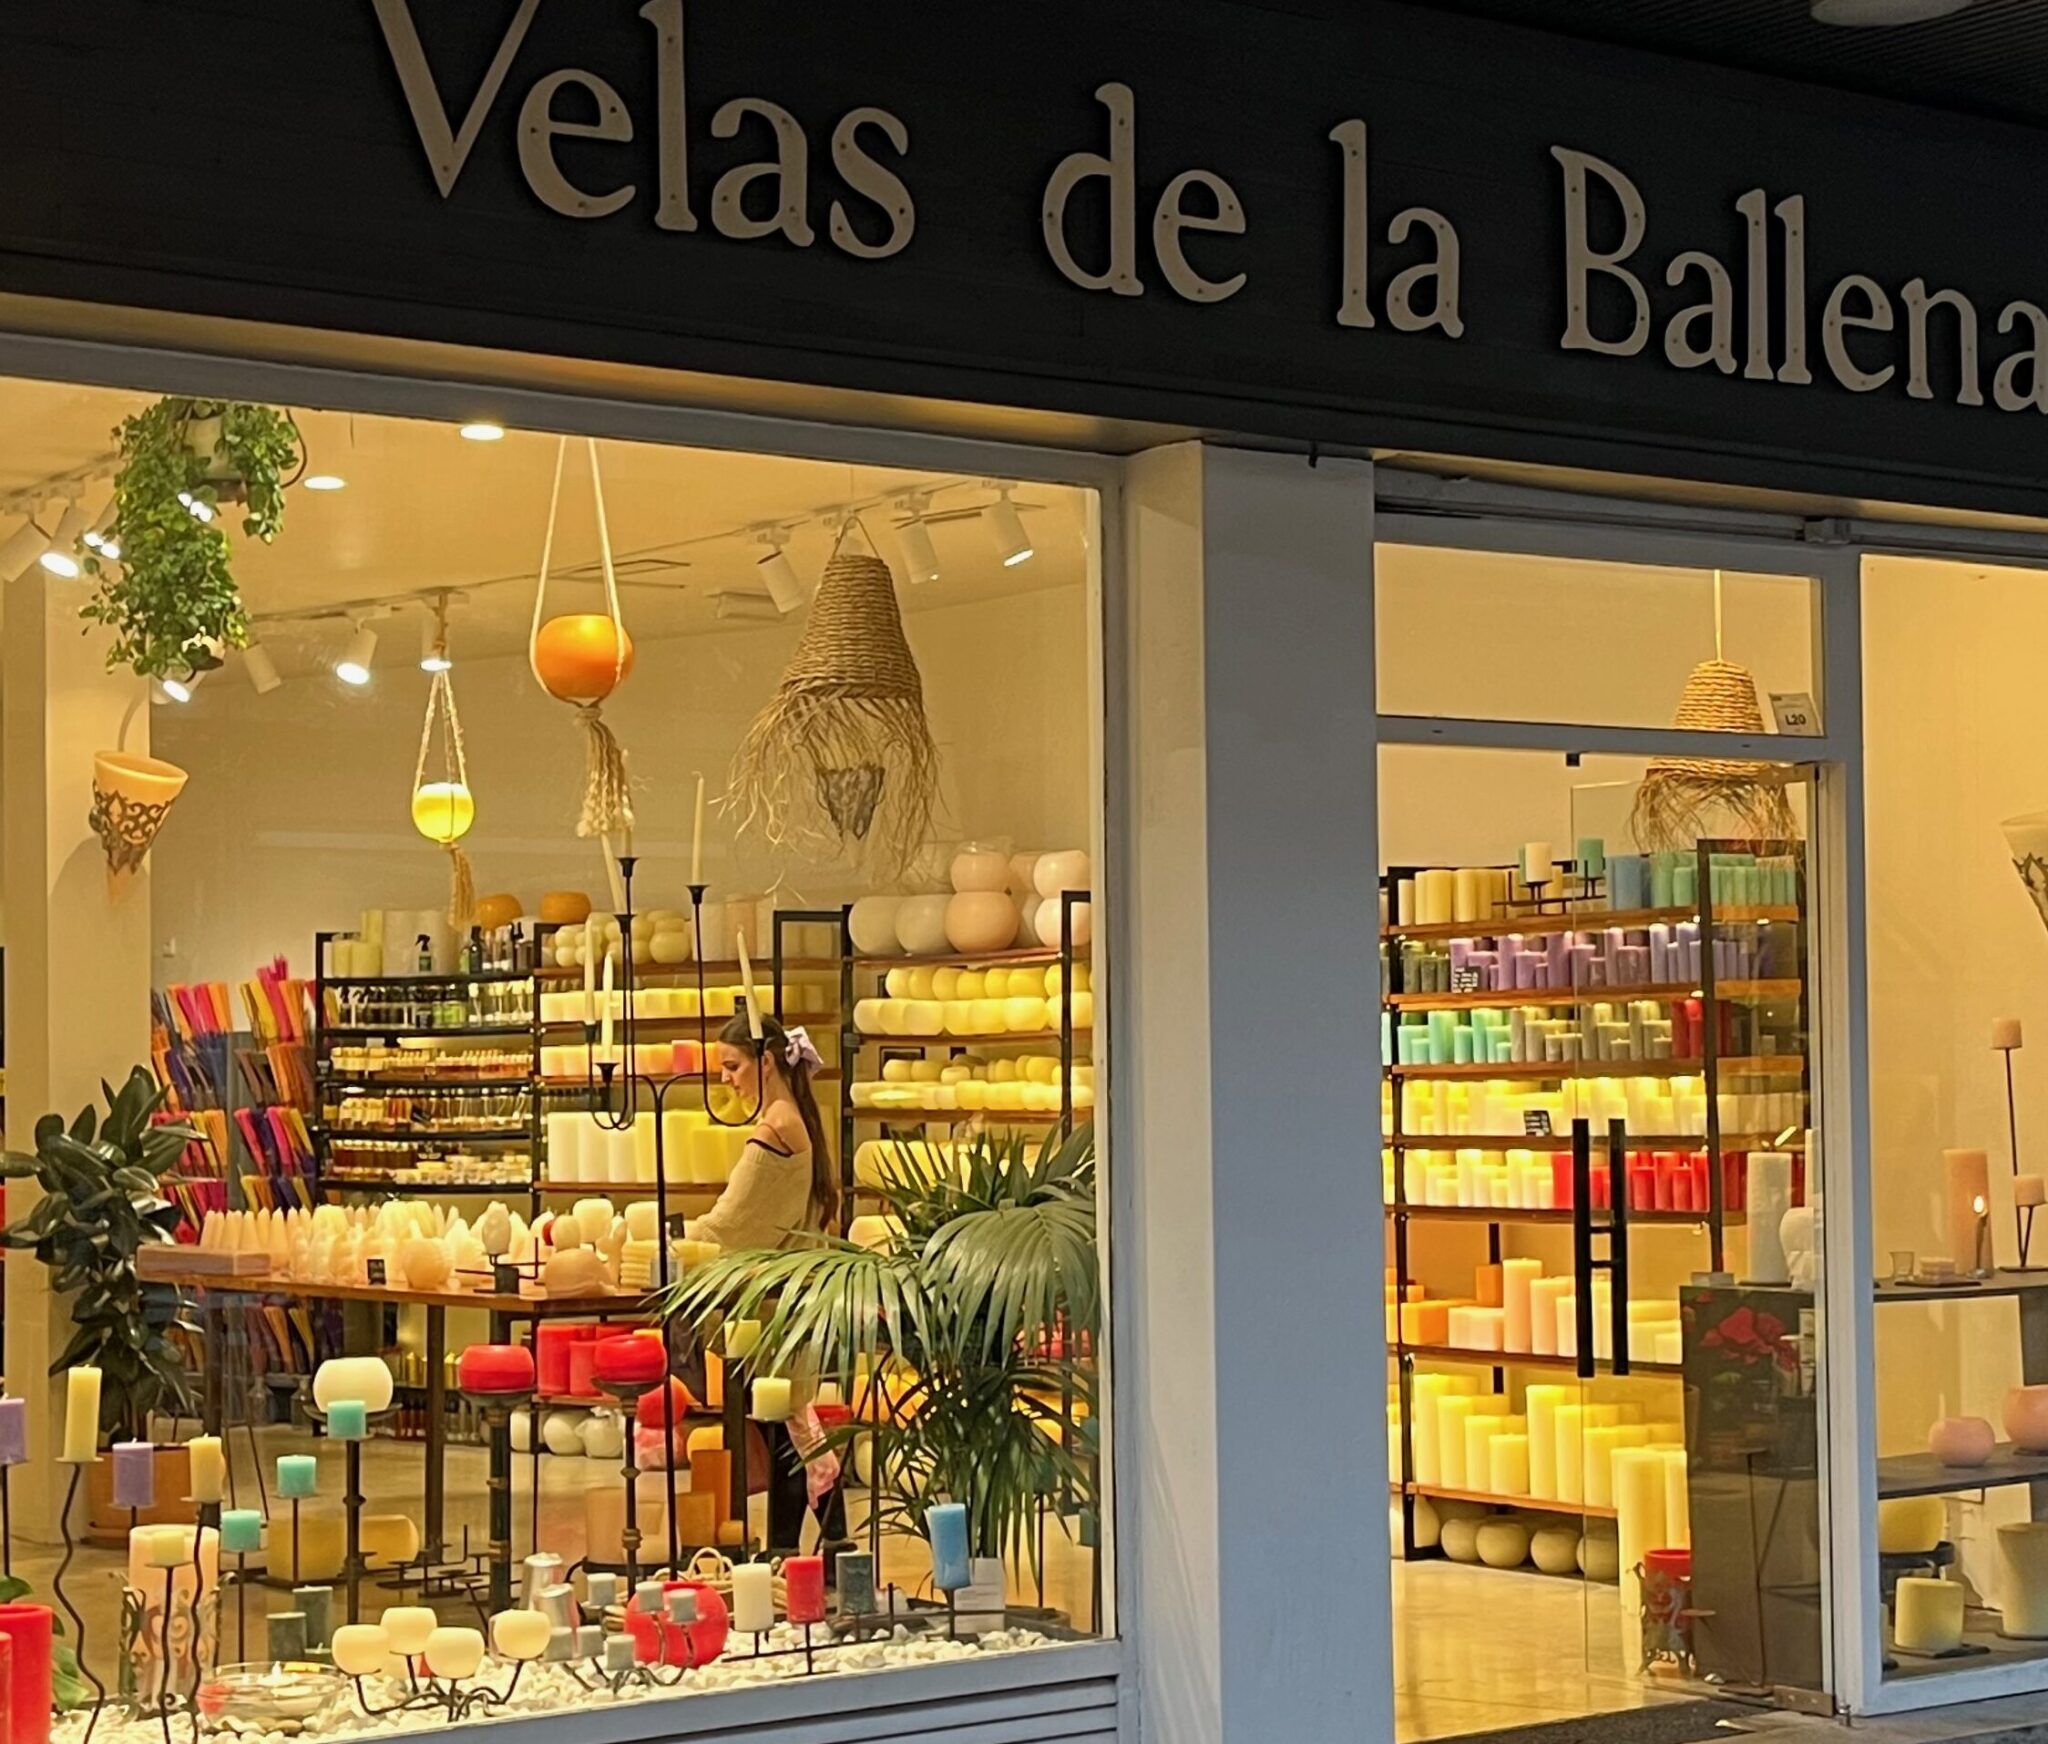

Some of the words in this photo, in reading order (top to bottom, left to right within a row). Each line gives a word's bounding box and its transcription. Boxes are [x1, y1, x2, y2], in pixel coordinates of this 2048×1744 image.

[373, 0, 916, 259] Velas
[1042, 82, 1248, 303] de
[1328, 119, 1465, 339] la
[1550, 145, 2048, 415] Ballena
[1785, 713, 1806, 725] L20
